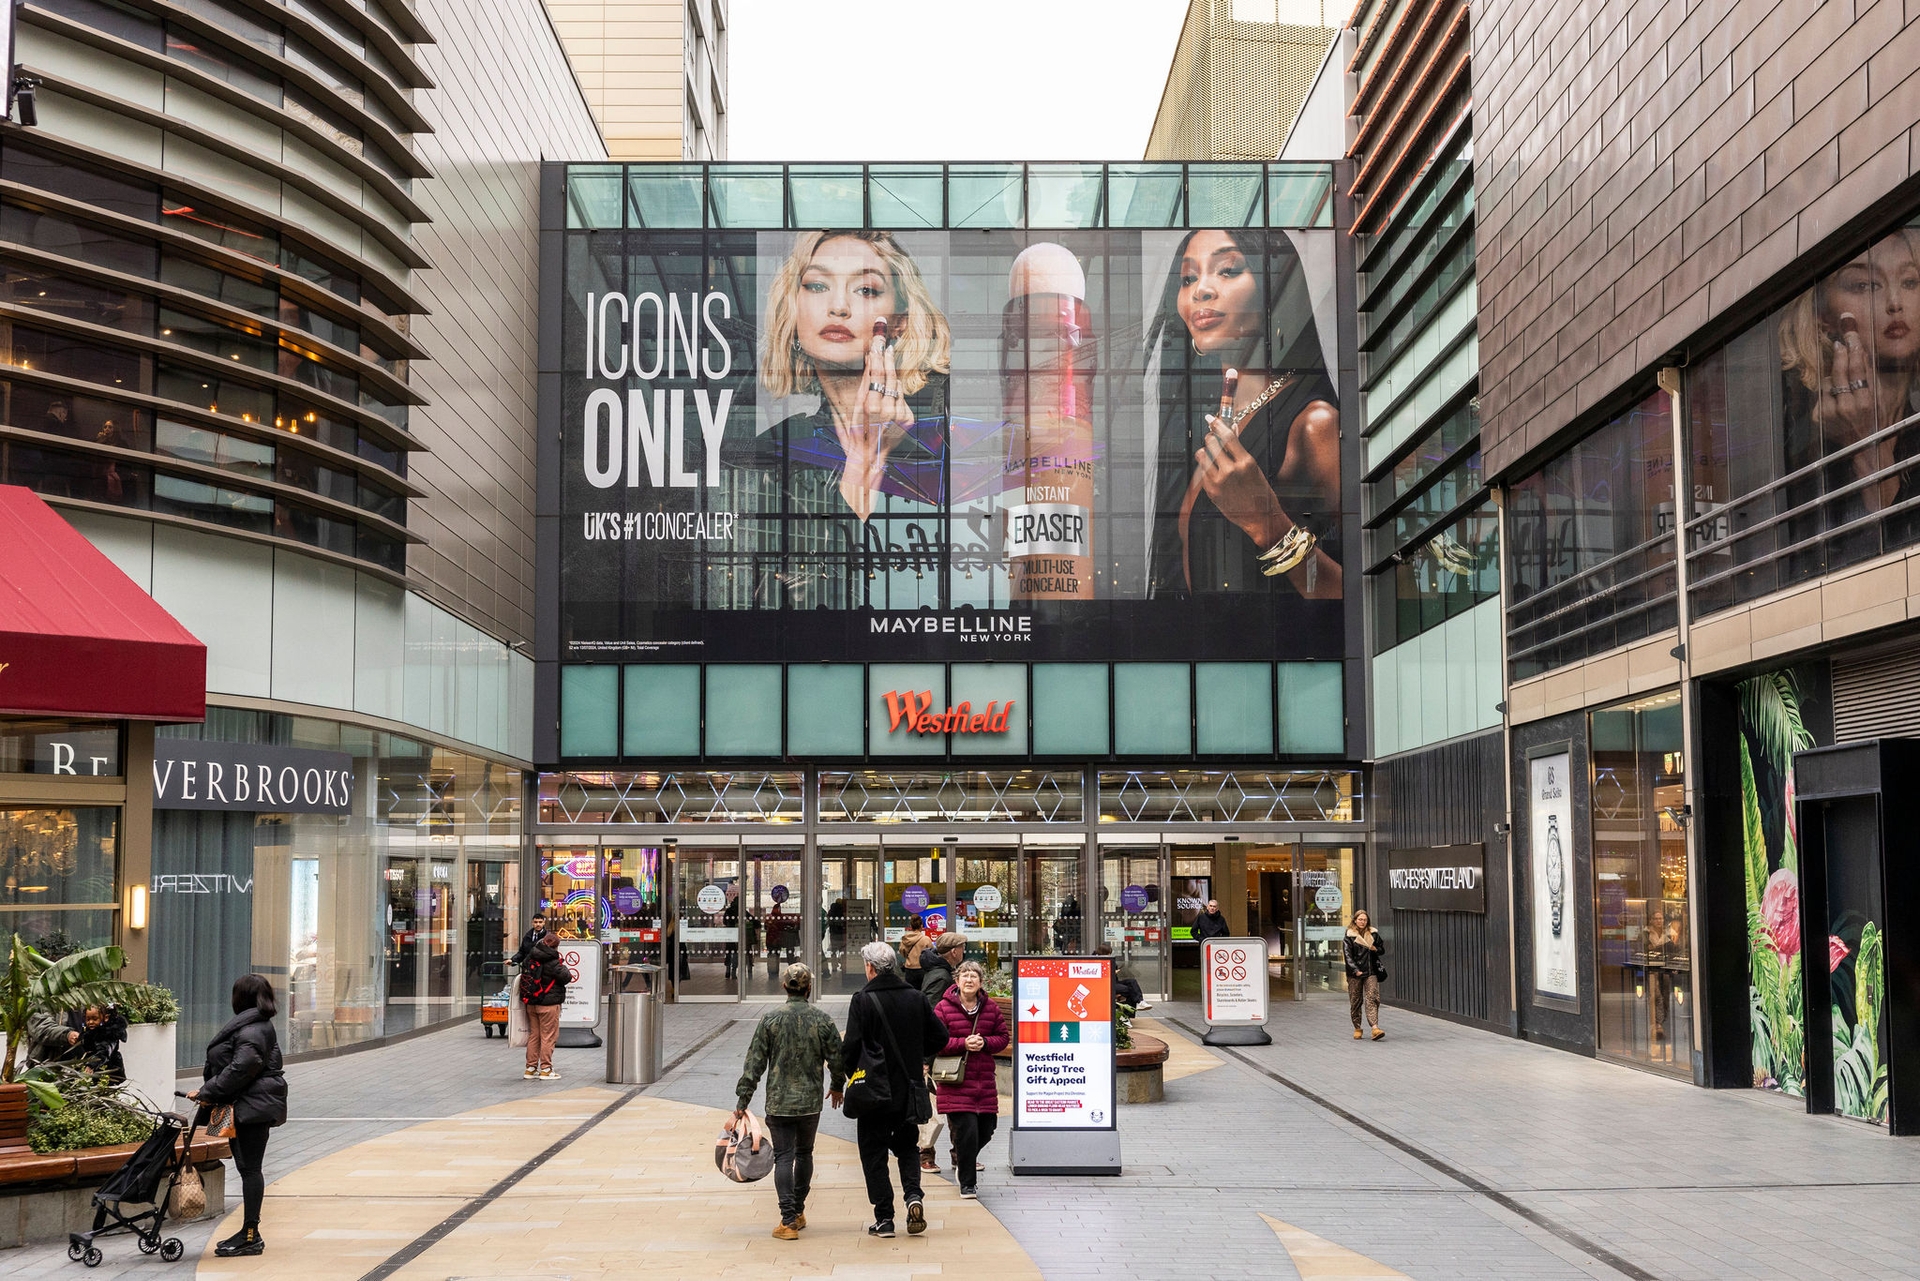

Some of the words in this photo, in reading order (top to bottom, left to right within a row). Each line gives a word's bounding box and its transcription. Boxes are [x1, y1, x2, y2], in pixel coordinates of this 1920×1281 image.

[586, 292, 732, 380] ICONS
[583, 388, 734, 488] ONLY
[1005, 456, 1092, 474] MAYBELLINE
[1026, 486, 1071, 502] INSTANT
[584, 512, 621, 540] UK'S
[623, 512, 642, 540] #1
[1014, 513, 1084, 545] ERASER
[1022, 559, 1075, 575] MULTI-USE
[1019, 577, 1079, 594] CONCEALER
[870, 616, 1032, 633] MAYBELLINE
[960, 634, 991, 643] NEW
[994, 633, 1032, 642] YORK
[881, 689, 1016, 735] Westfield
[1072, 966, 1098, 976] Westfield
[1026, 1053, 1074, 1062] Westfield
[1026, 1065, 1060, 1074] Giving
[1062, 1065, 1085, 1074] Tree
[1026, 1076, 1048, 1085] Gift
[1049, 1076, 1086, 1086] Appeal
